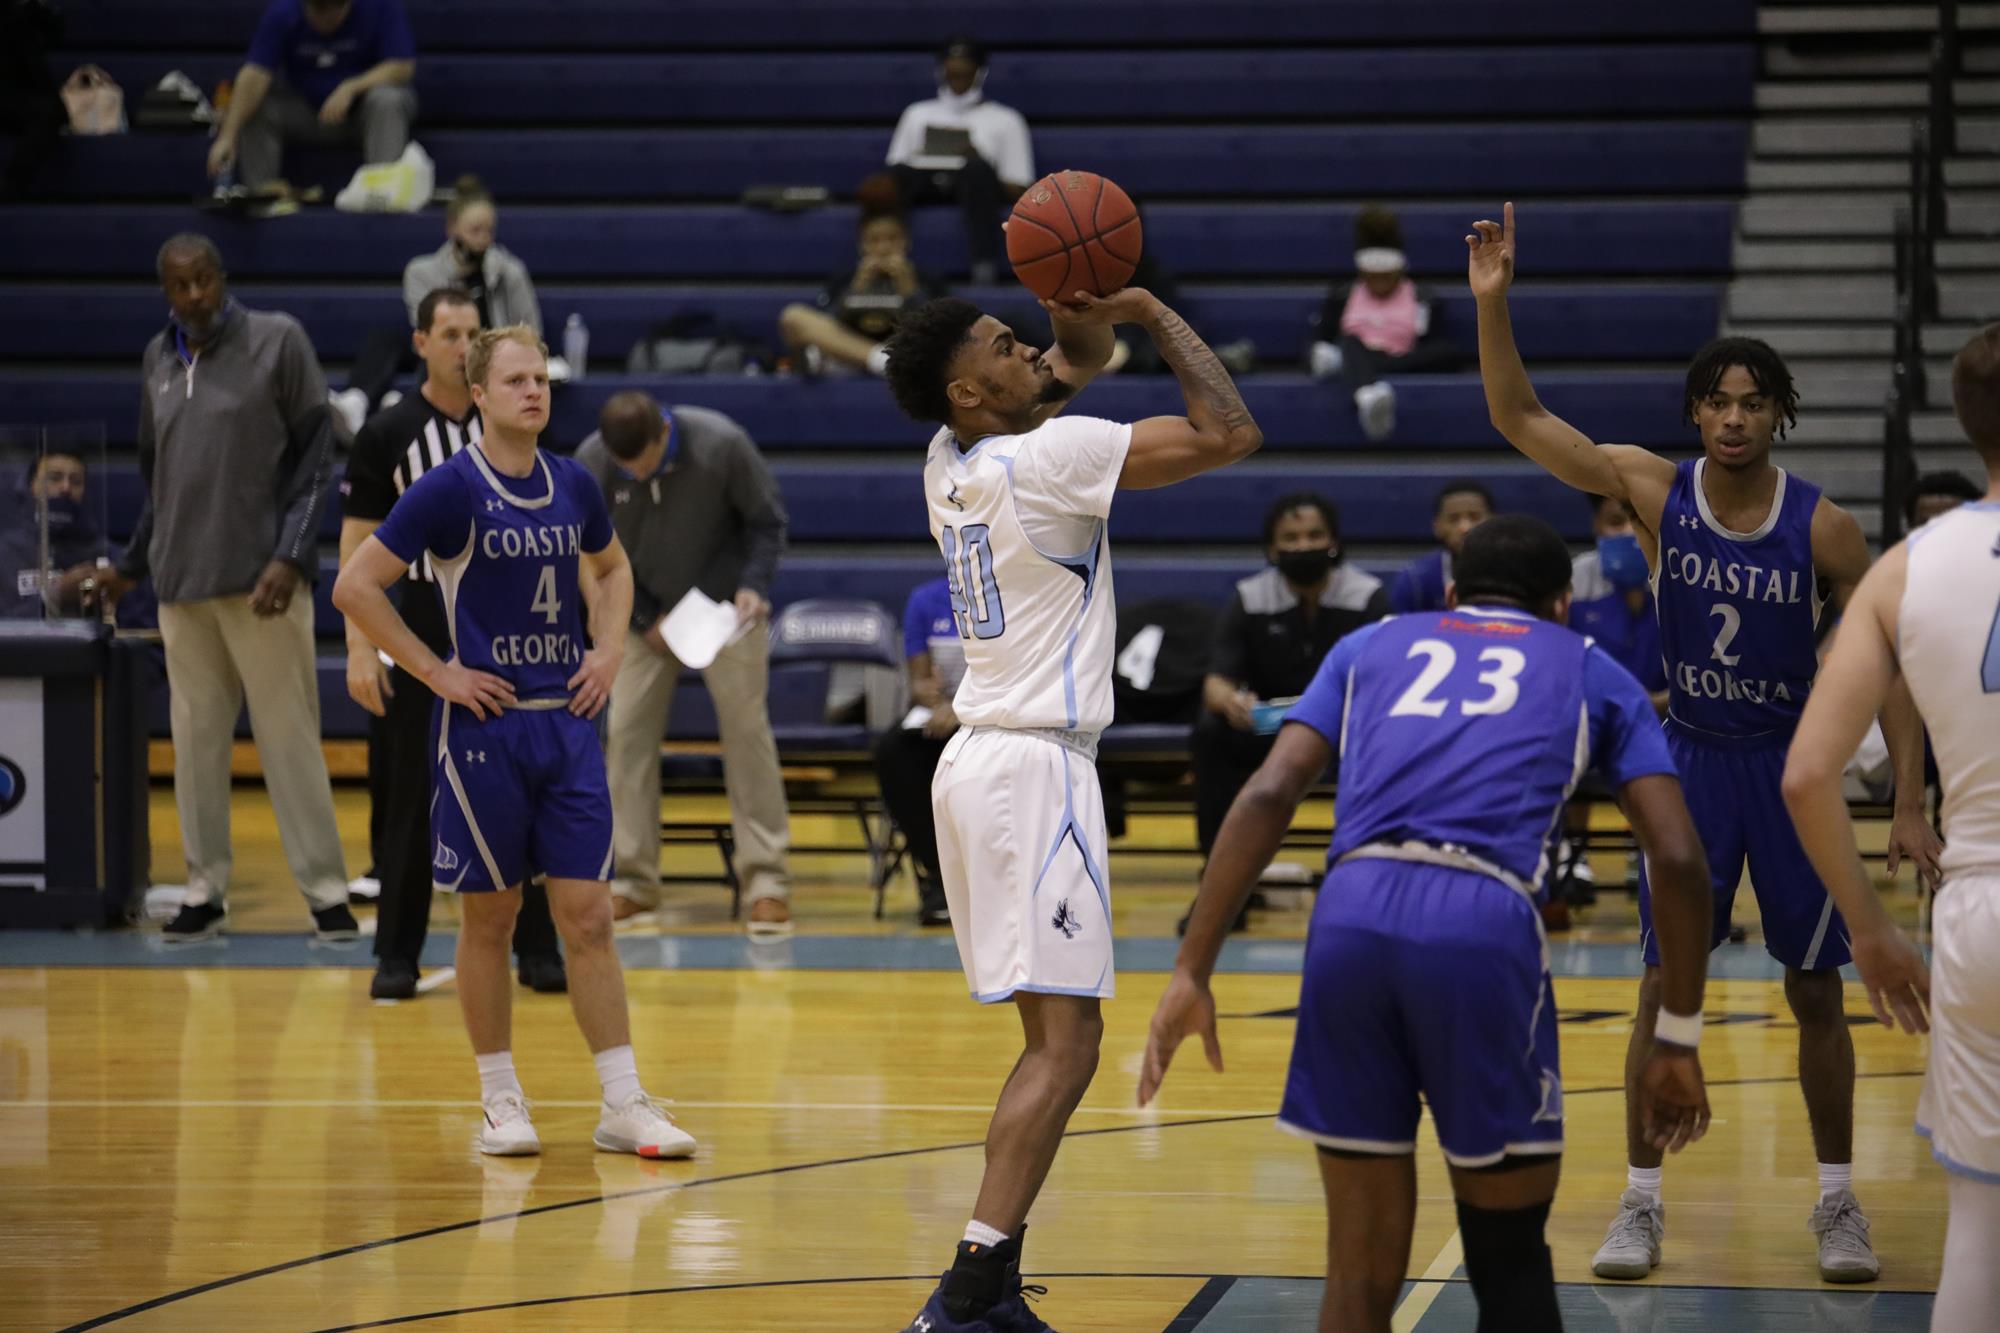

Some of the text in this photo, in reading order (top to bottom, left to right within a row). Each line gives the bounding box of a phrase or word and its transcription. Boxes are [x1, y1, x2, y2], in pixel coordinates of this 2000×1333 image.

[483, 523, 583, 559] COASTA
[530, 565, 562, 624] 4
[1667, 547, 1802, 604] COASTAL
[1709, 603, 1741, 666] 2
[1388, 638, 1527, 719] 23
